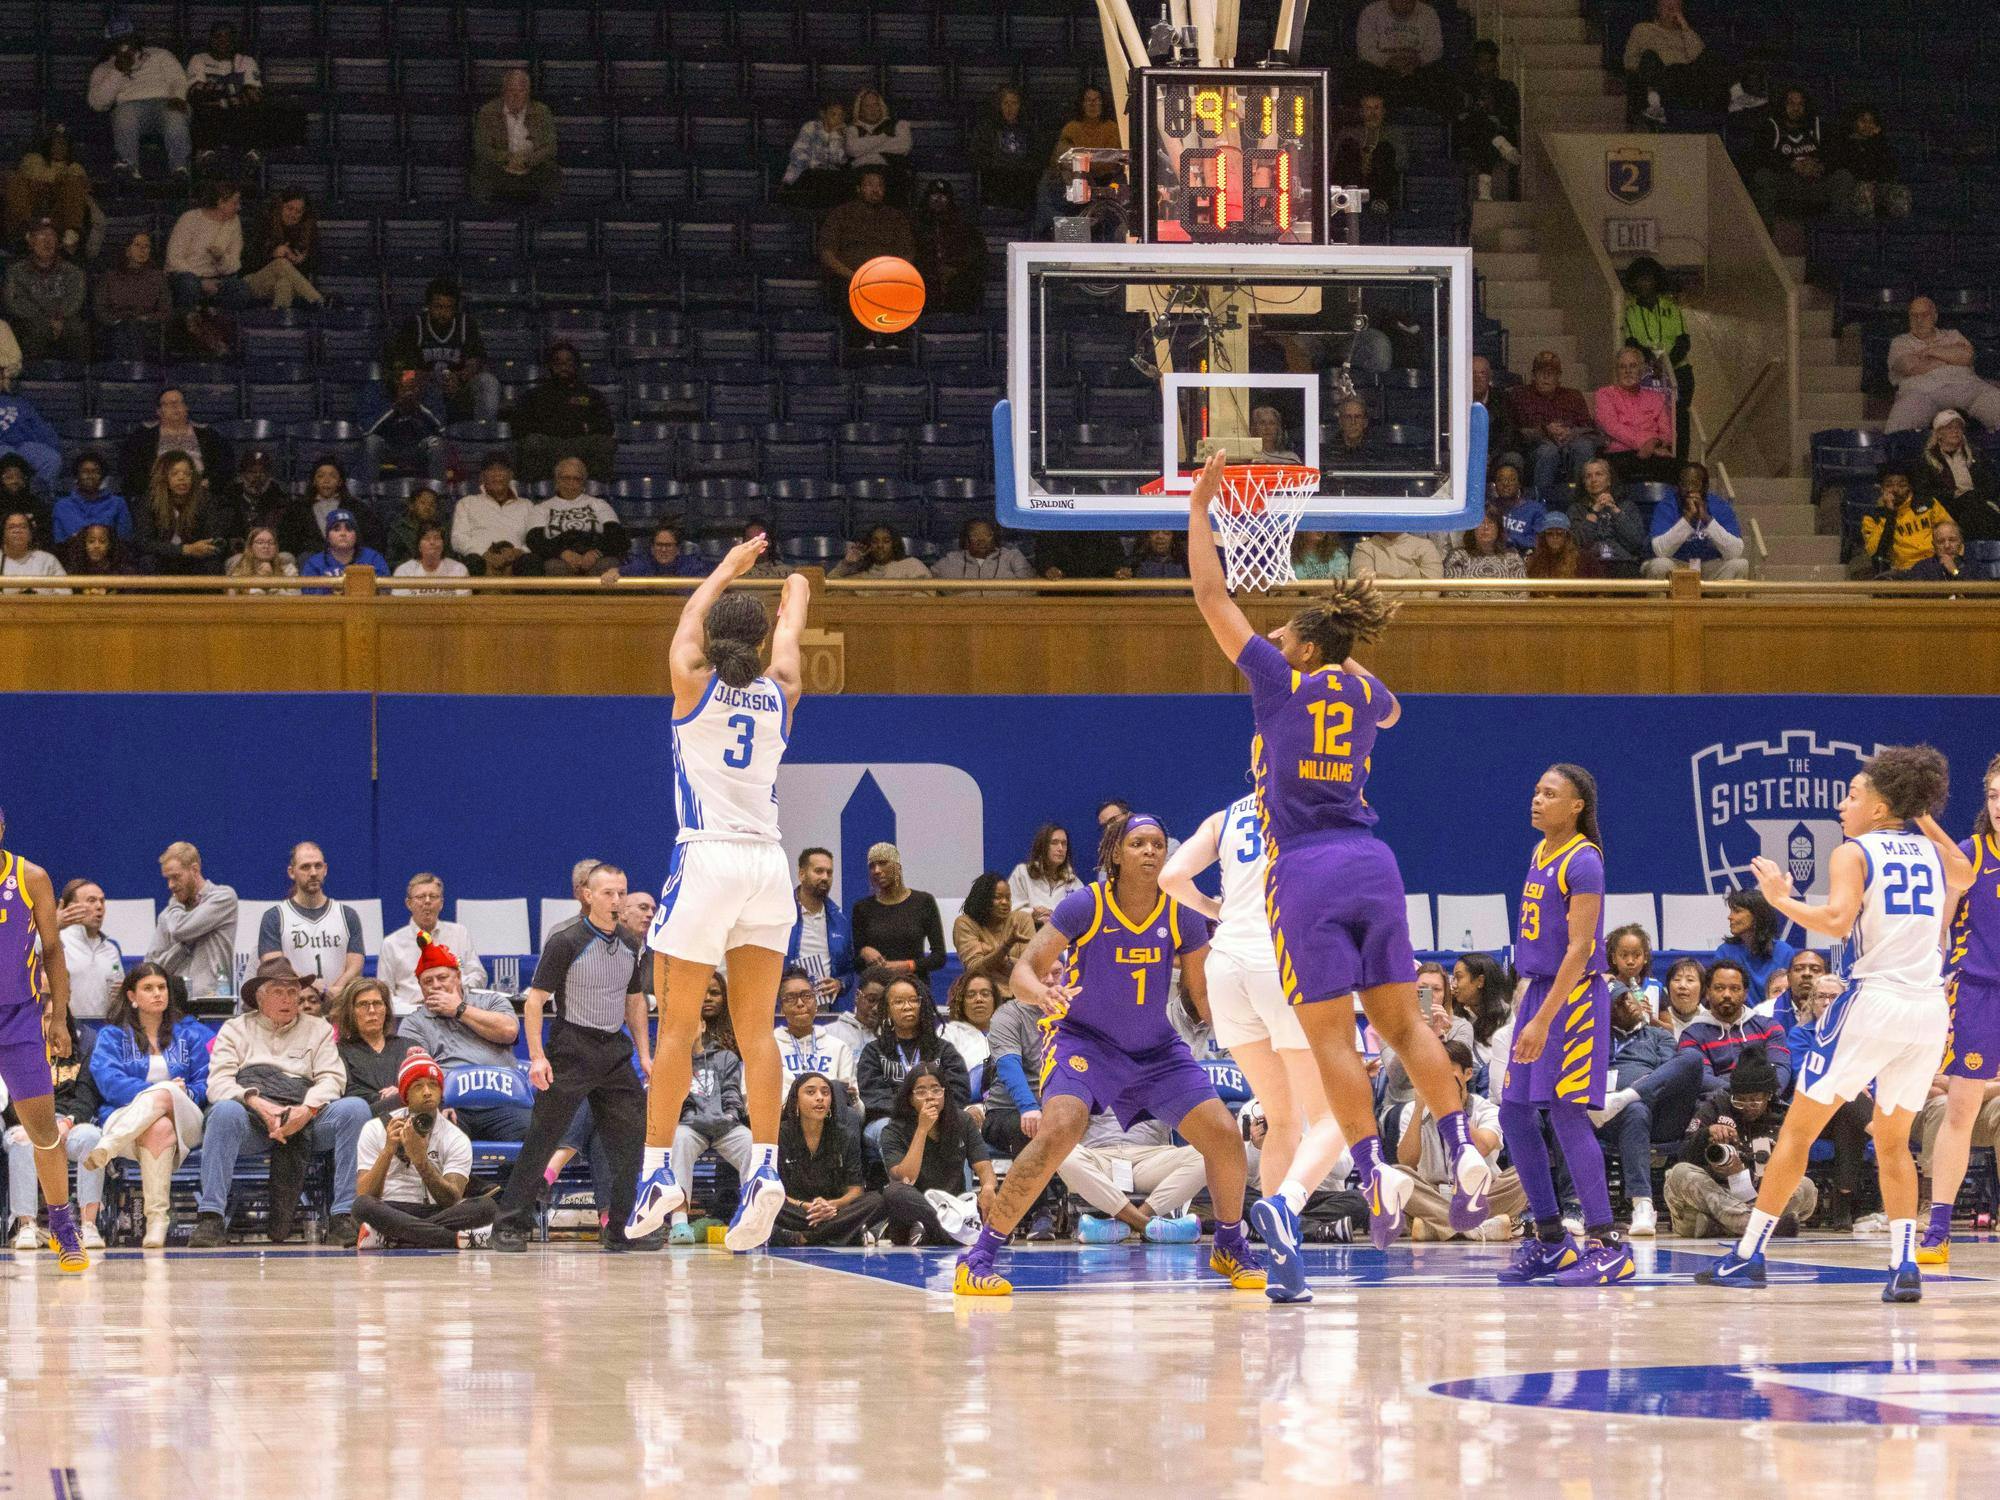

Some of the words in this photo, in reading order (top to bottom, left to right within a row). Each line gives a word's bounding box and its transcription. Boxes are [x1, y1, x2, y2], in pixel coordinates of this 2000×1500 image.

[1196, 91, 1305, 136] 9:11
[1216, 150, 1290, 232] 11
[1620, 163, 1640, 193] 2
[1618, 223, 1647, 247] EXIT
[1030, 499, 1074, 509] SPALDING
[1503, 515, 1527, 533] KE
[714, 686, 780, 712] JACKSON
[1306, 699, 1354, 756] 12
[723, 713, 756, 770] 3
[1299, 759, 1354, 783] WILLIAMS
[1788, 758, 1810, 773] THE
[1712, 777, 1848, 826] SISTERHO
[1236, 815, 1262, 864] 3
[1881, 841, 1923, 857] MAIR
[1523, 881, 1545, 900] LSU
[1883, 862, 1935, 917] 22
[1521, 900, 1540, 941] 23
[291, 929, 341, 949] Duke
[315, 954, 323, 979] 1
[1115, 947, 1162, 963] LSU
[1130, 967, 1146, 1005] 1
[784, 1054, 833, 1073] UKE
[457, 1069, 512, 1097] DUKE
[1202, 1066, 1244, 1093] UKE
